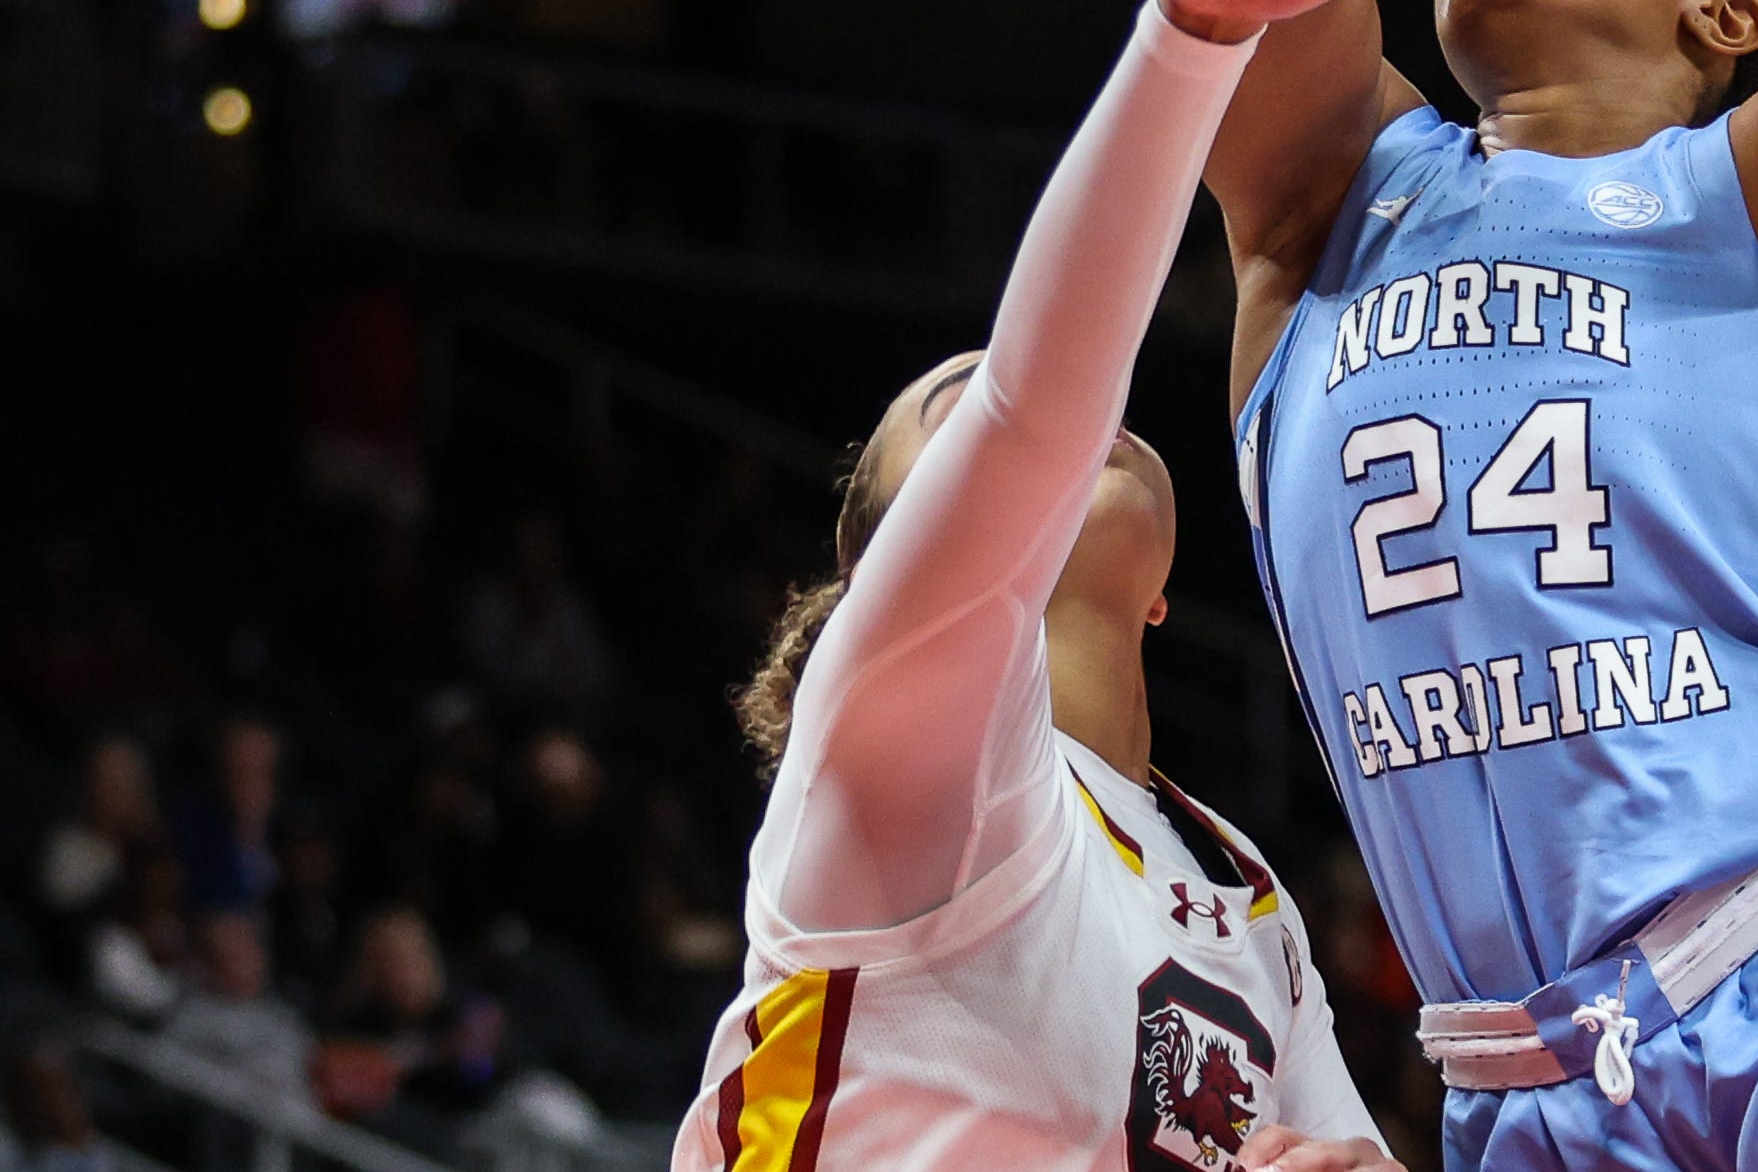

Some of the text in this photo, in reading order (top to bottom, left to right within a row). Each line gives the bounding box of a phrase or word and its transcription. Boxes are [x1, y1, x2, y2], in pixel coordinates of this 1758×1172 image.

[1326, 260, 1630, 396] NORTH
[1340, 398, 1614, 621] 24
[1343, 627, 1730, 778] CAROLINA
